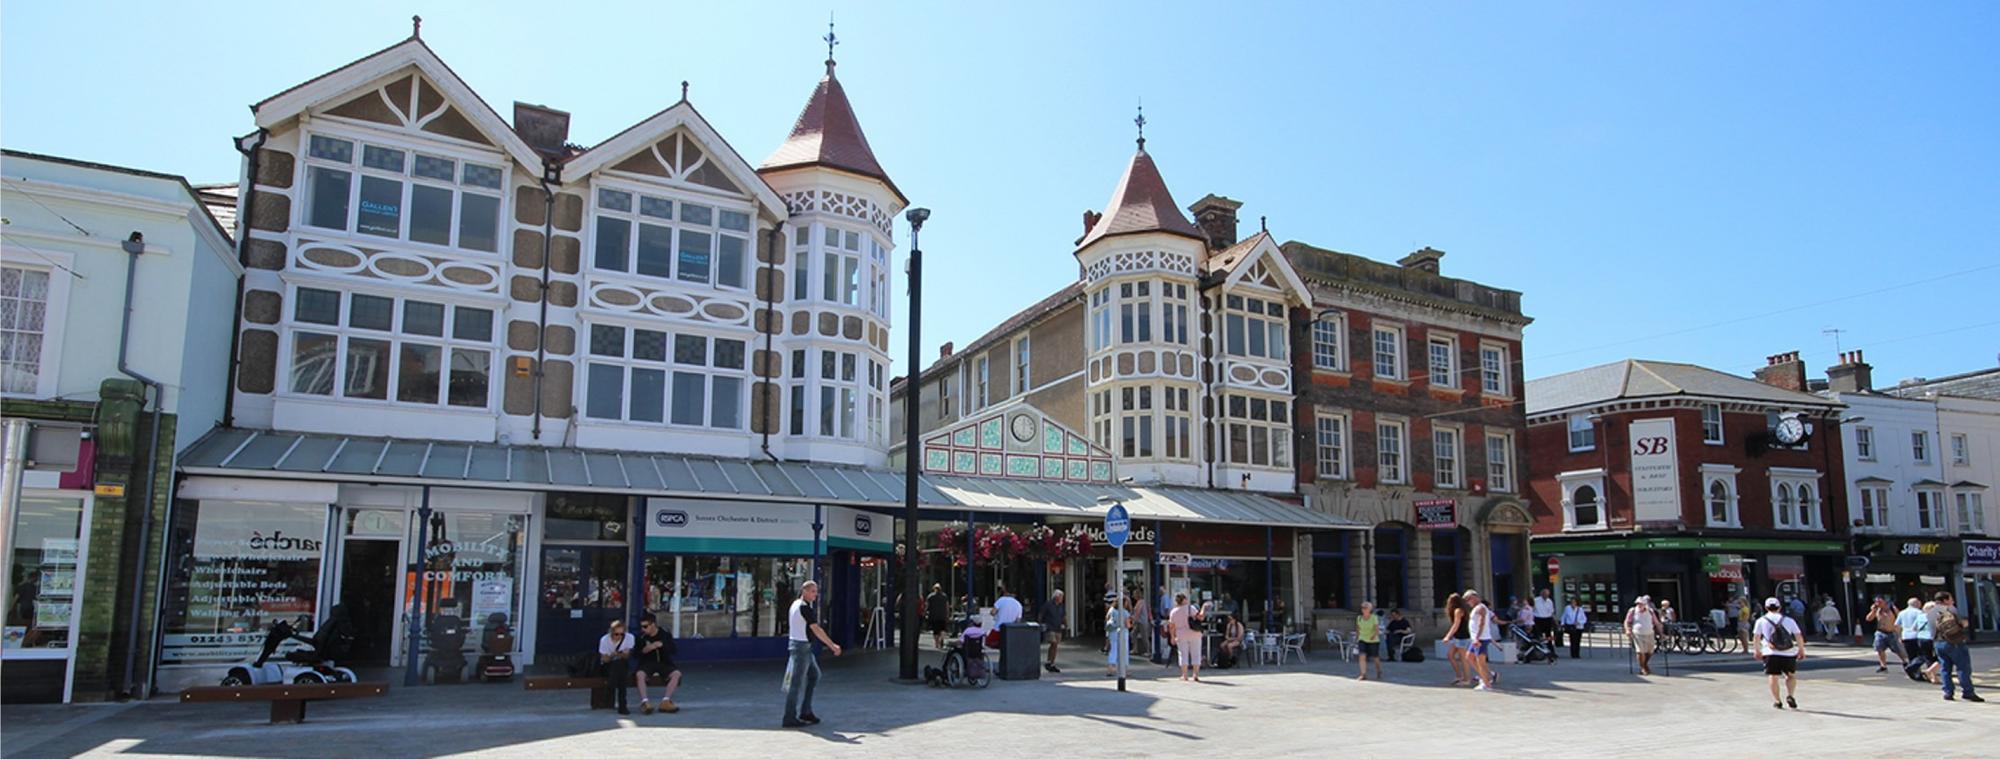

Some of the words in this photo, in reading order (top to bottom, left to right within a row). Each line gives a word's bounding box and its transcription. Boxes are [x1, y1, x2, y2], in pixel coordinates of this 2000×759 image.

[1634, 436, 1668, 456] SB
[1088, 525, 1156, 541] Hord's
[425, 542, 509, 560] MOBILITY
[1901, 543, 1938, 555] SUBWAY
[1967, 544, 1998, 559] Charity
[450, 559, 484, 567] AND
[194, 566, 267, 576] Wheelchairs
[423, 571, 507, 581] COMFORT
[192, 581, 258, 591] Adjustable
[260, 581, 288, 590] Beds
[191, 595, 257, 604] Adjustable
[259, 595, 297, 604] Chairs
[190, 609, 240, 619] Walking
[243, 609, 269, 617] Aids
[190, 635, 235, 644] 01243
